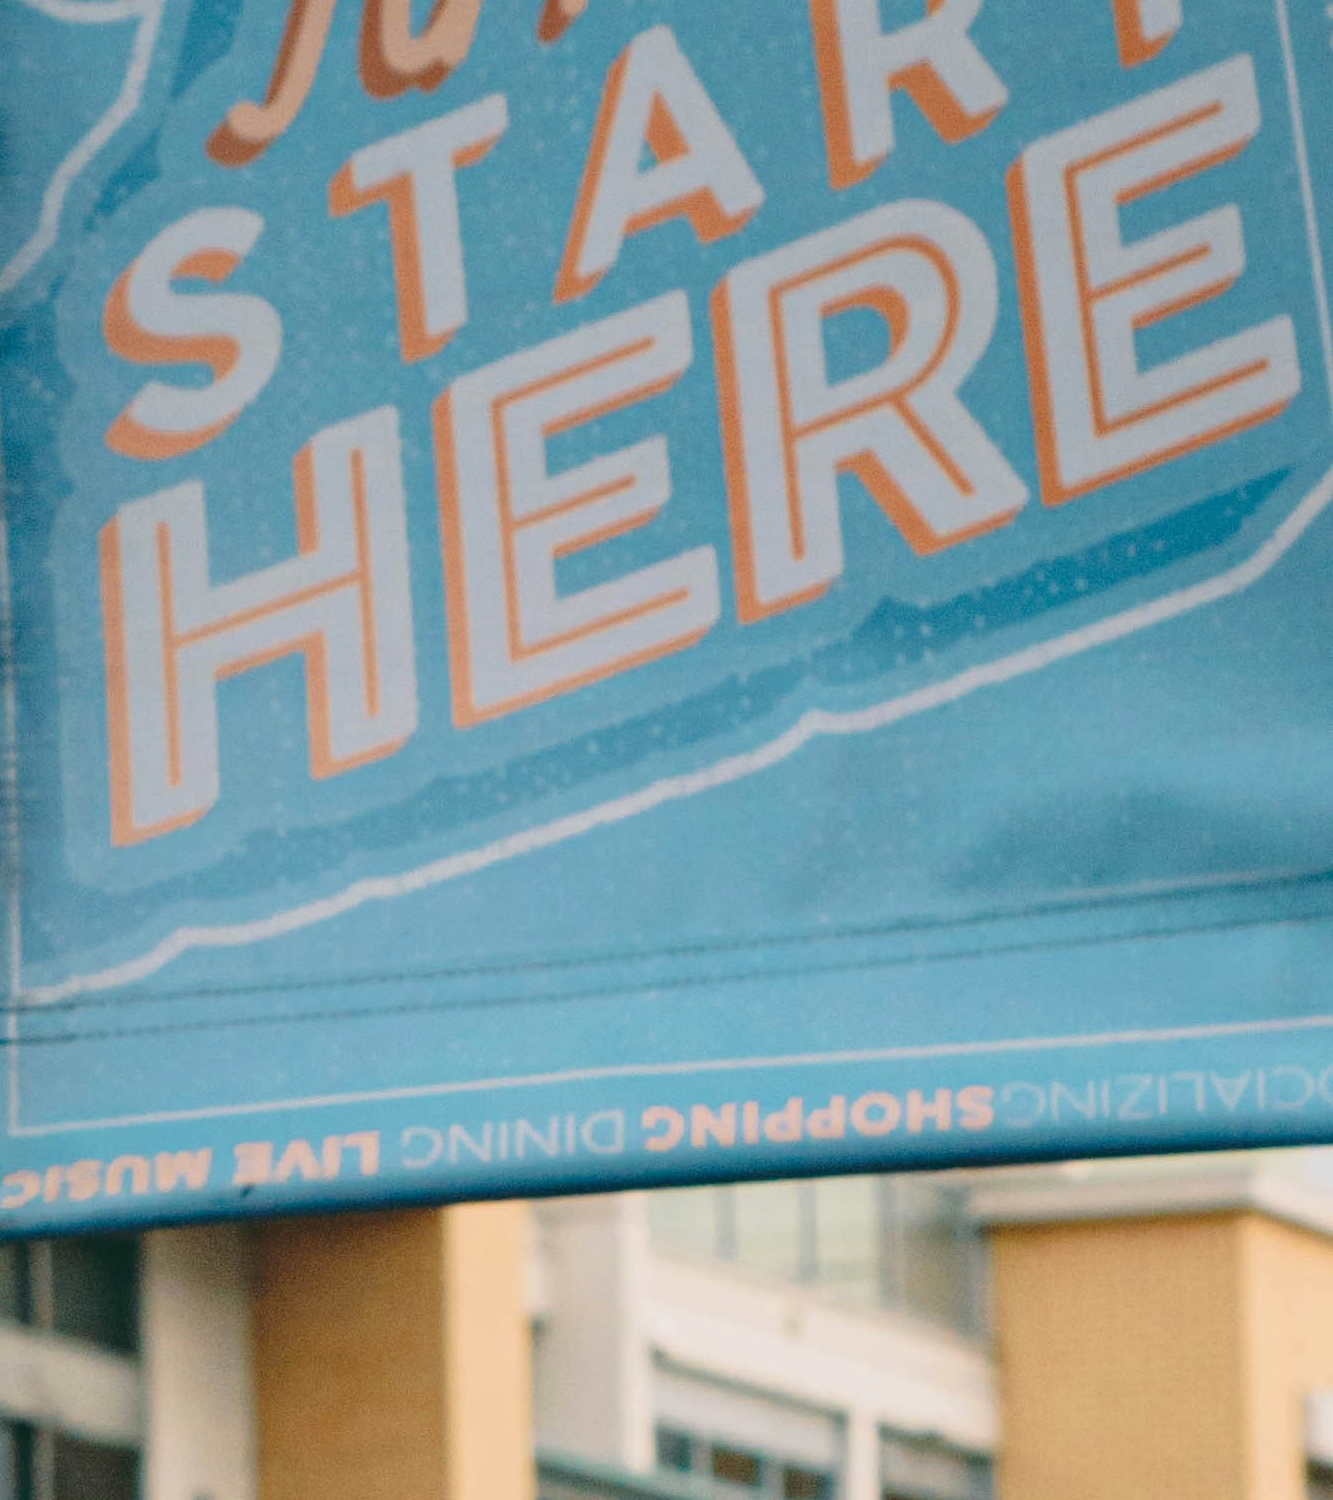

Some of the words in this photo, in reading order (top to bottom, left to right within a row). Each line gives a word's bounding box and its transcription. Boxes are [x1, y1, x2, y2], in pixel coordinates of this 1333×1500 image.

[99, 51, 1302, 848] HERE
[640, 1084, 996, 1152] SHOPPING
[1004, 1064, 1333, 1130] CIALIZING
[233, 1130, 380, 1186] LIVE
[401, 1108, 626, 1169] DINING
[0, 1148, 212, 1210] MUSIC
